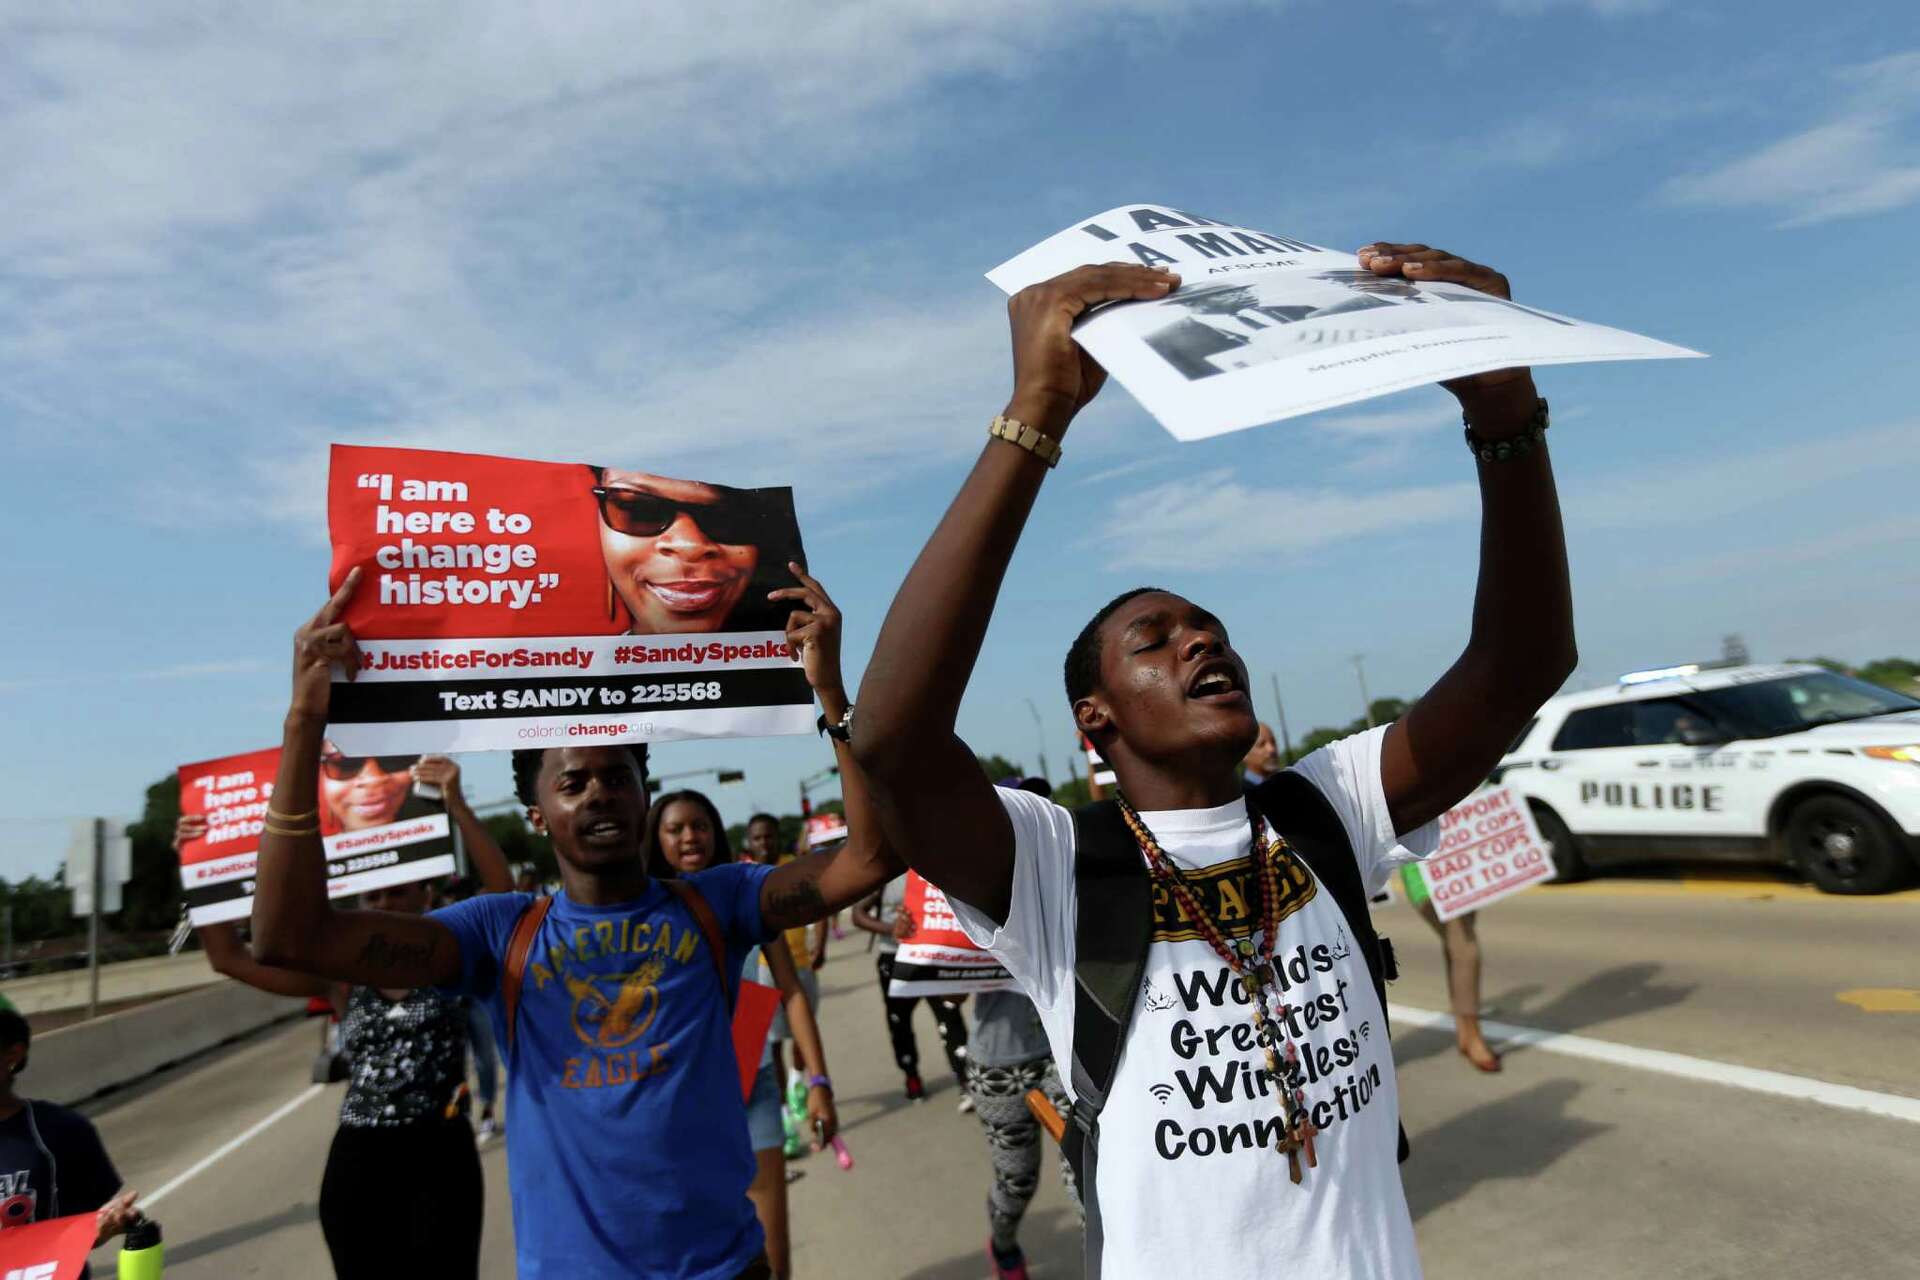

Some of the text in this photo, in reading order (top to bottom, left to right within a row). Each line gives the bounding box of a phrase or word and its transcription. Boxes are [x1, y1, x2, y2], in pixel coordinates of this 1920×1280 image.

[1080, 223, 1120, 242] I
[1127, 231, 1325, 266] A MAN
[400, 479, 468, 502] am
[376, 505, 532, 534] here to
[376, 538, 537, 574] change
[380, 573, 560, 609] history.”
[359, 640, 790, 670] #JusticeForSandy #SandySpeaks
[439, 681, 722, 711] Text SANDY to 225568
[518, 720, 655, 738] colorofchange.org
[1440, 789, 1510, 830] UPPORT
[1580, 780, 1724, 811] POLICE
[1429, 834, 1530, 881] BAD COPS
[1435, 875, 1474, 901] GOT
[1482, 862, 1507, 882] TO
[1513, 847, 1541, 870] GO
[1173, 943, 1334, 1012] Wolds
[1170, 979, 1349, 1060] Greatest
